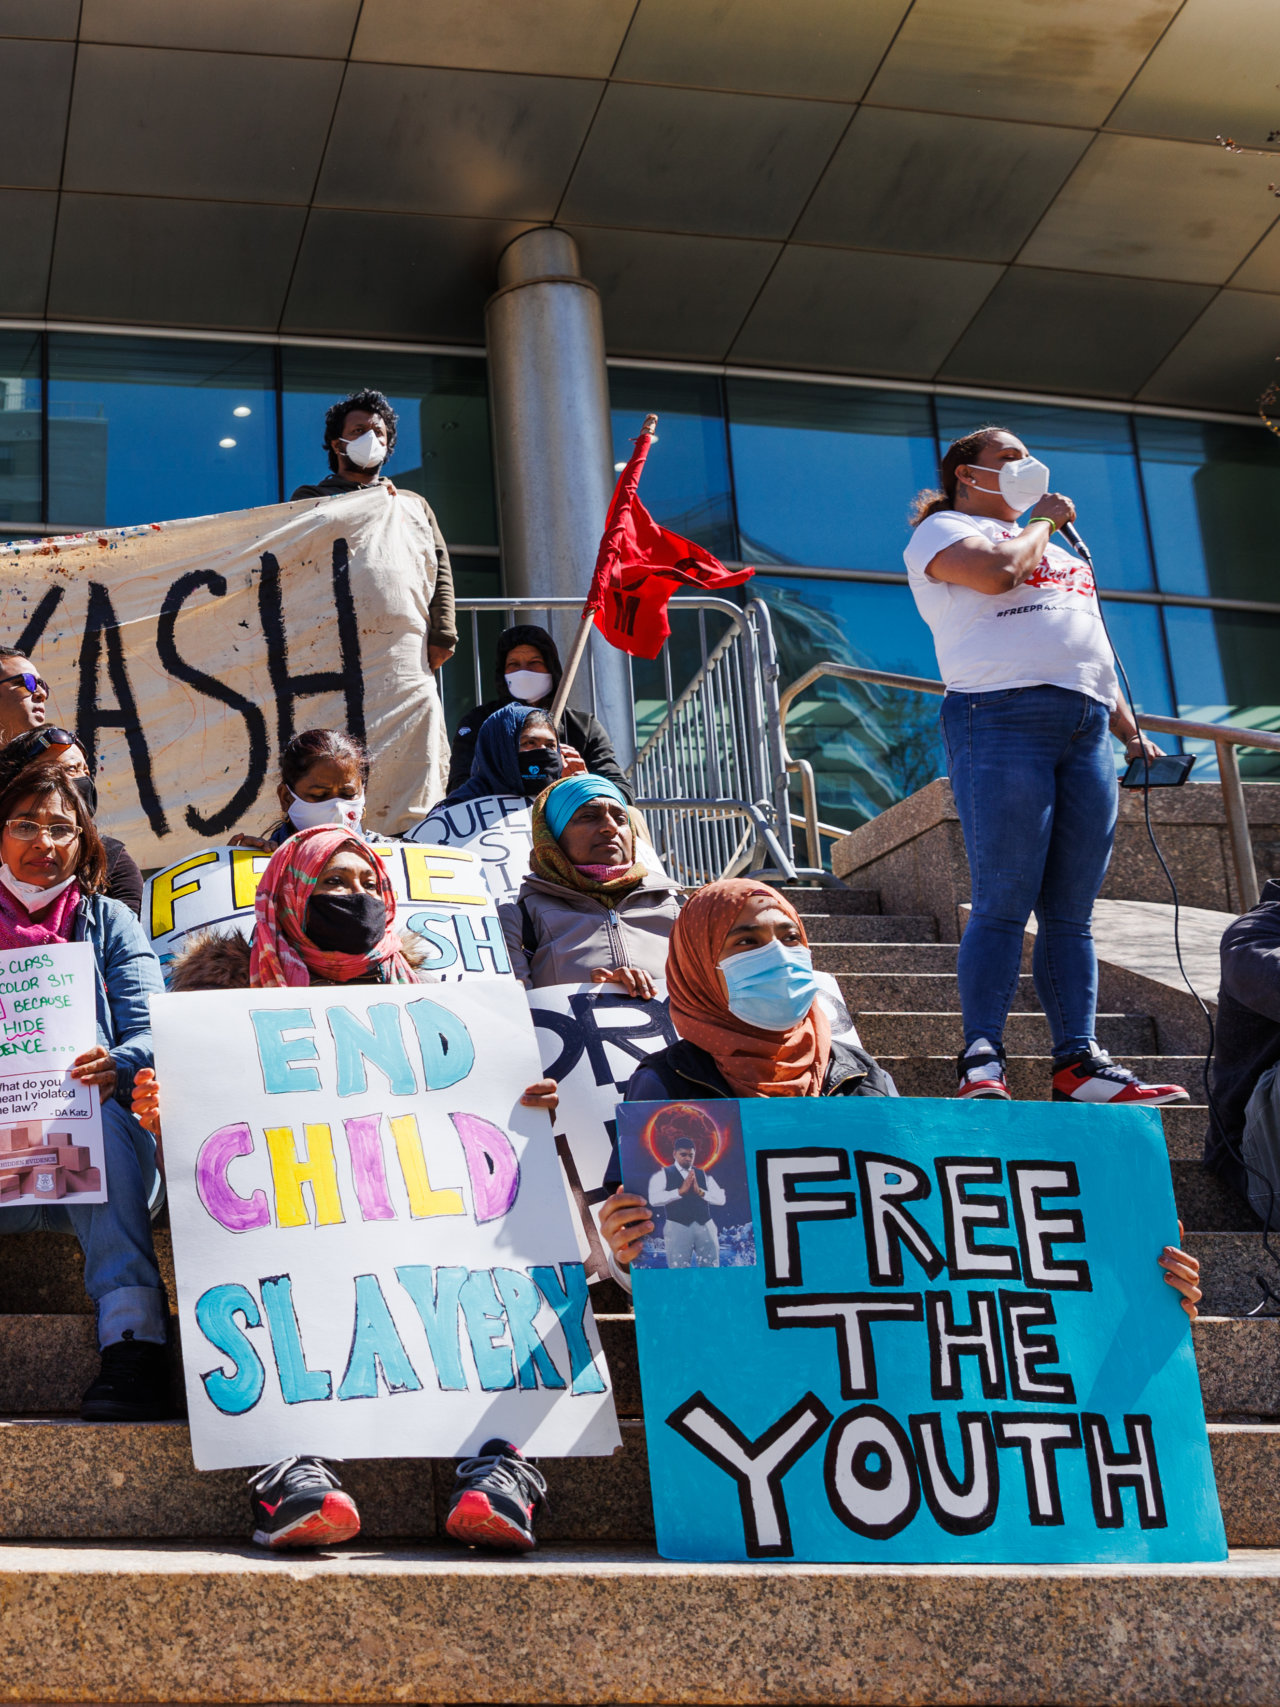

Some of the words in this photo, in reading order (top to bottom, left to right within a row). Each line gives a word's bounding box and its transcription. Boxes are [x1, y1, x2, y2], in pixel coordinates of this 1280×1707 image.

[9, 953, 54, 974] CLASS
[47, 973, 74, 987] SIT
[13, 994, 72, 1013] BECAUSE
[4, 1017, 45, 1036] HIDE
[249, 998, 476, 1098] END
[22, 1079, 37, 1090] do
[40, 1078, 62, 1091] you
[31, 1089, 76, 1100] violated
[11, 1102, 38, 1115] law?
[55, 1109, 68, 1117] DA
[69, 1108, 88, 1117] Katz
[195, 1112, 520, 1234] CHILD
[756, 1147, 1093, 1291] FREE
[194, 1262, 608, 1416] SLAVERY
[765, 1290, 1077, 1404] THE
[665, 1390, 1168, 1558] YOUTH
